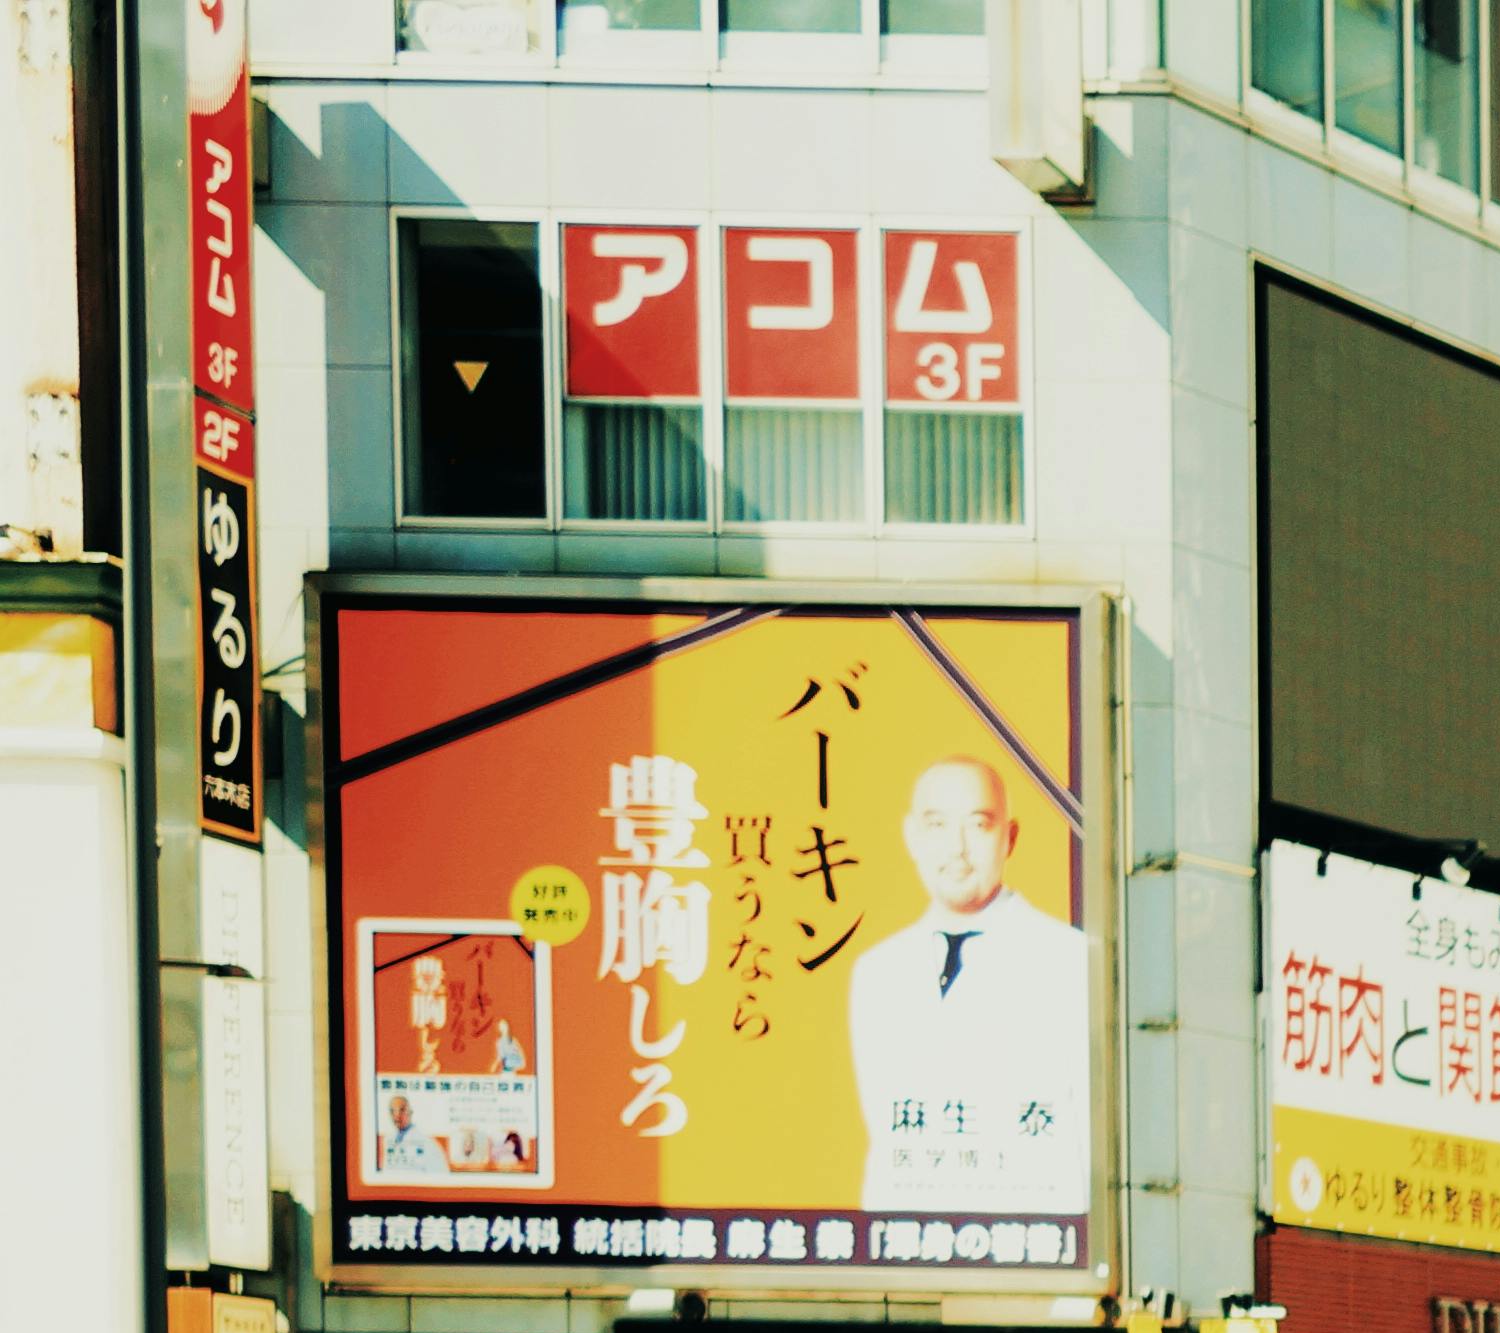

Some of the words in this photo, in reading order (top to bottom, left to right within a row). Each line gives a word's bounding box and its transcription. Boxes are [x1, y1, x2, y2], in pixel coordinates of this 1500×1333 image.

[203, 138, 236, 318] アコム
[591, 232, 993, 333] アコム
[207, 342, 237, 388] 3F
[916, 342, 1003, 402] 3F
[202, 412, 240, 459] 2F
[202, 486, 248, 768] ゆるり
[778, 662, 870, 972] バーキン
[597, 754, 711, 1138] 豊胸しろ
[724, 815, 773, 1041] 買うなら
[348, 1215, 560, 1254] 東京美容外科
